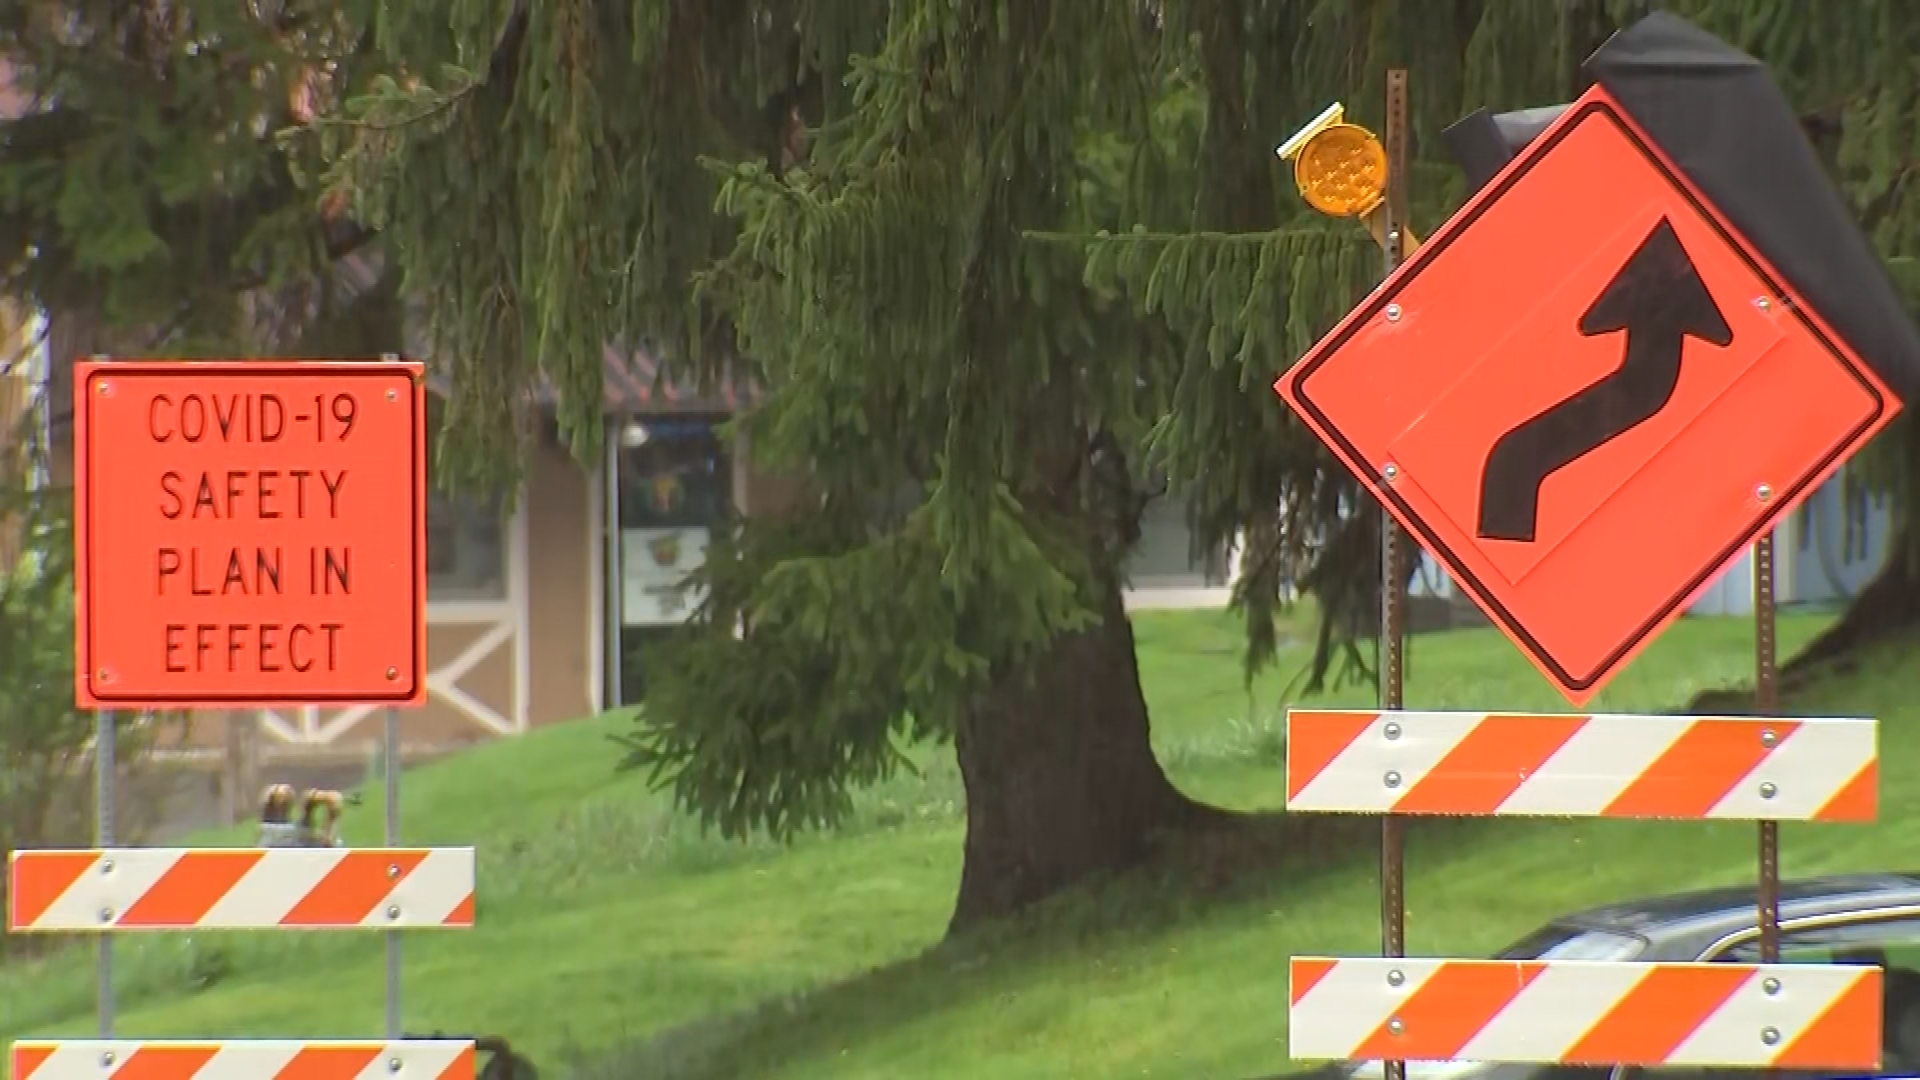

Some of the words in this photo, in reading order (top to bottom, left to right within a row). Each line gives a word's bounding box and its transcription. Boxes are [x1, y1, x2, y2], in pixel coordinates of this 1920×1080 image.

[148, 393, 358, 443] COVID-19
[159, 470, 348, 520] SAFETY
[157, 547, 283, 596] PLAN
[309, 547, 352, 596] IN
[165, 623, 343, 673] EFFECT
